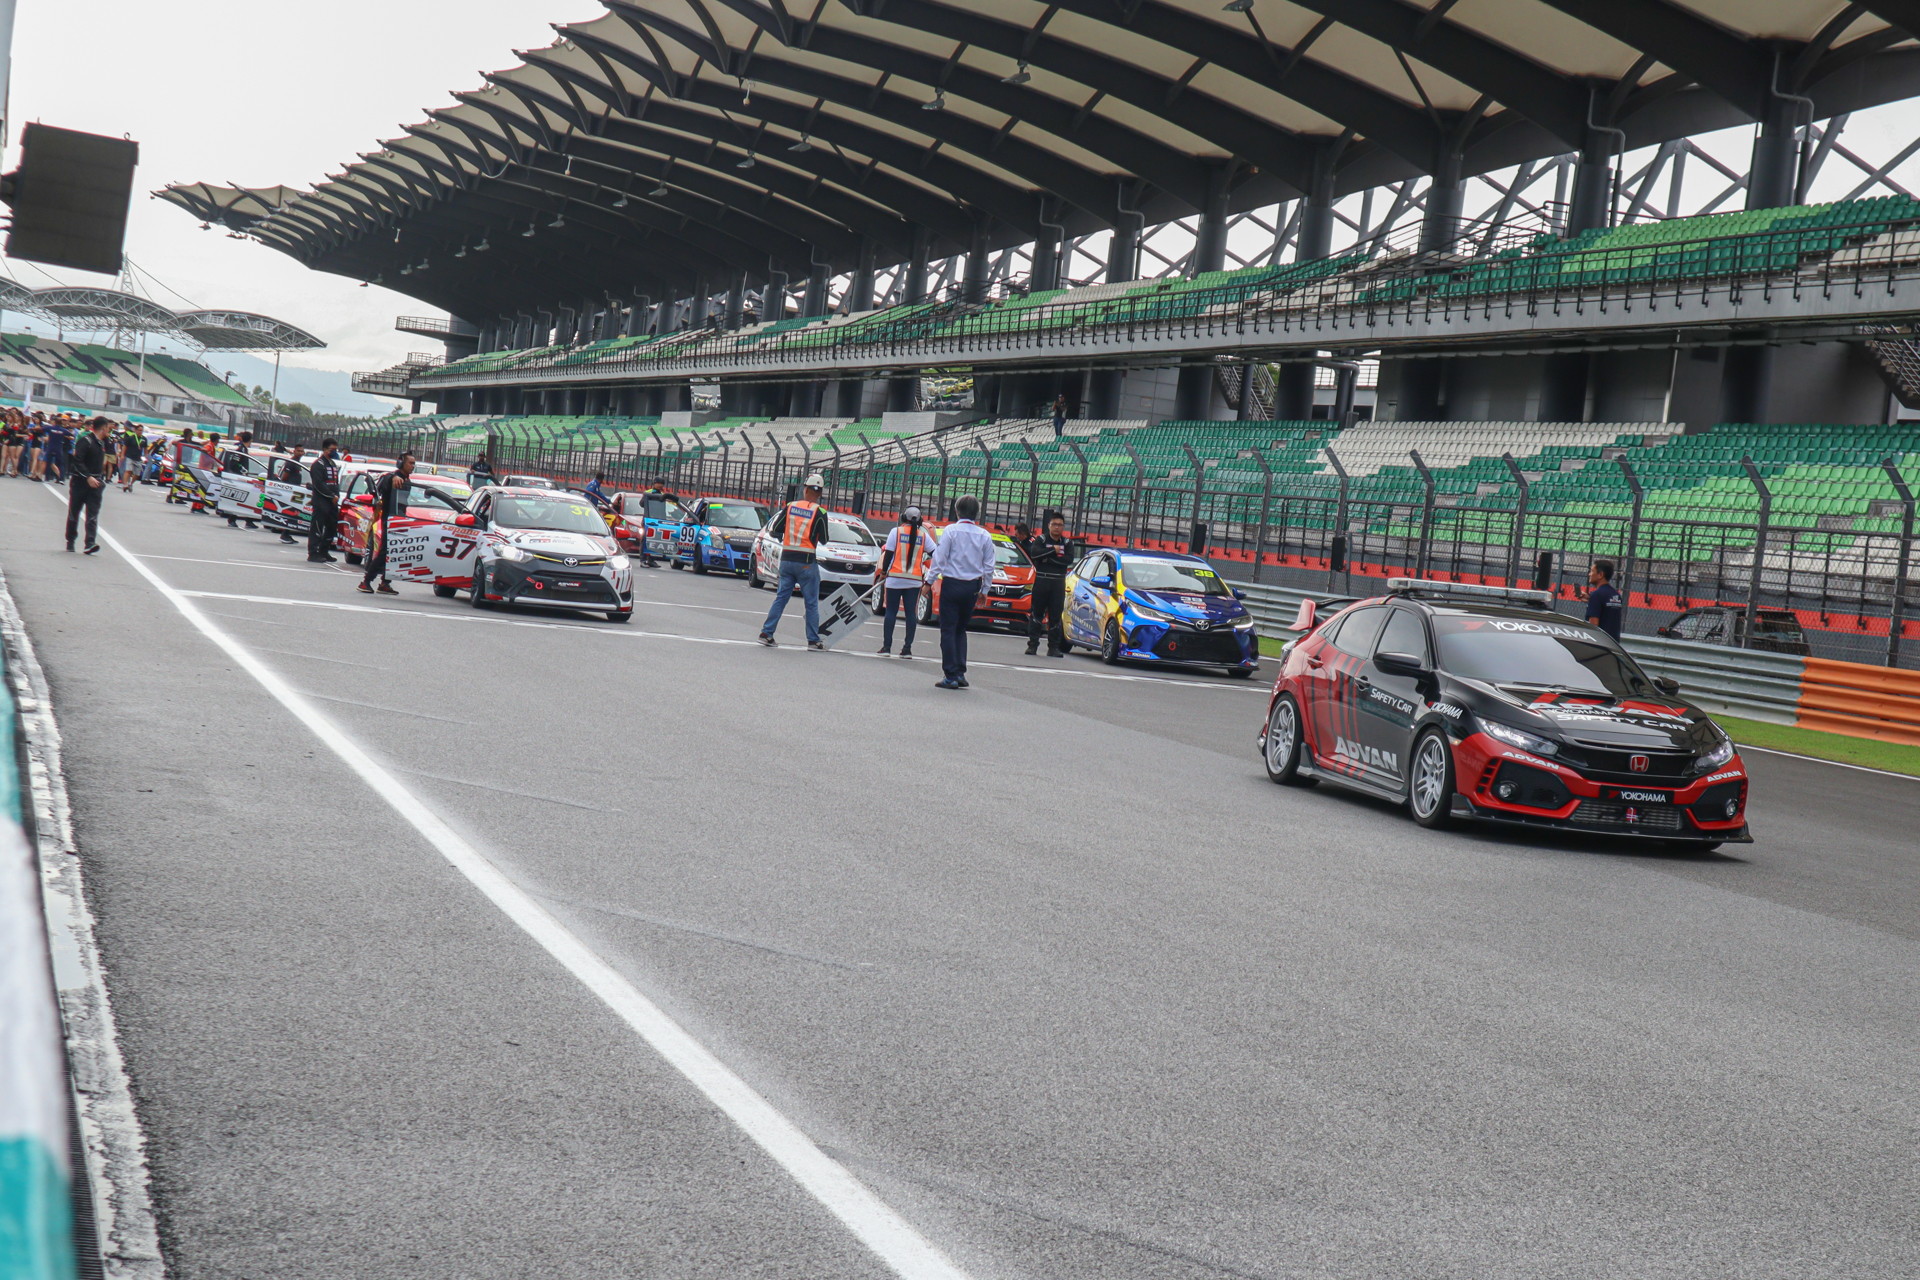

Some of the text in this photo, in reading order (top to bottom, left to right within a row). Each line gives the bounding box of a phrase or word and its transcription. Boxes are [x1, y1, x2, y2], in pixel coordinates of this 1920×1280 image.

[273, 483, 294, 491] ENEOS
[570, 504, 592, 516] 37
[790, 507, 812, 518] MARSHAL
[387, 536, 430, 546] OYOTA
[680, 526, 695, 542] 99
[436, 536, 477, 560] 37
[1488, 620, 1598, 642] YOKOHAMA
[1370, 688, 1413, 715] SAFETY CAR
[1527, 702, 1695, 724] ADVAN
[1546, 708, 1618, 717] YOKOHAMA
[1557, 714, 1688, 732] SAFETY CAR
[1334, 736, 1398, 772] ADVAN
[1502, 751, 1560, 770] ADVAN
[1707, 770, 1742, 783] ADVAN
[1620, 790, 1666, 803] YOKOHAMA
